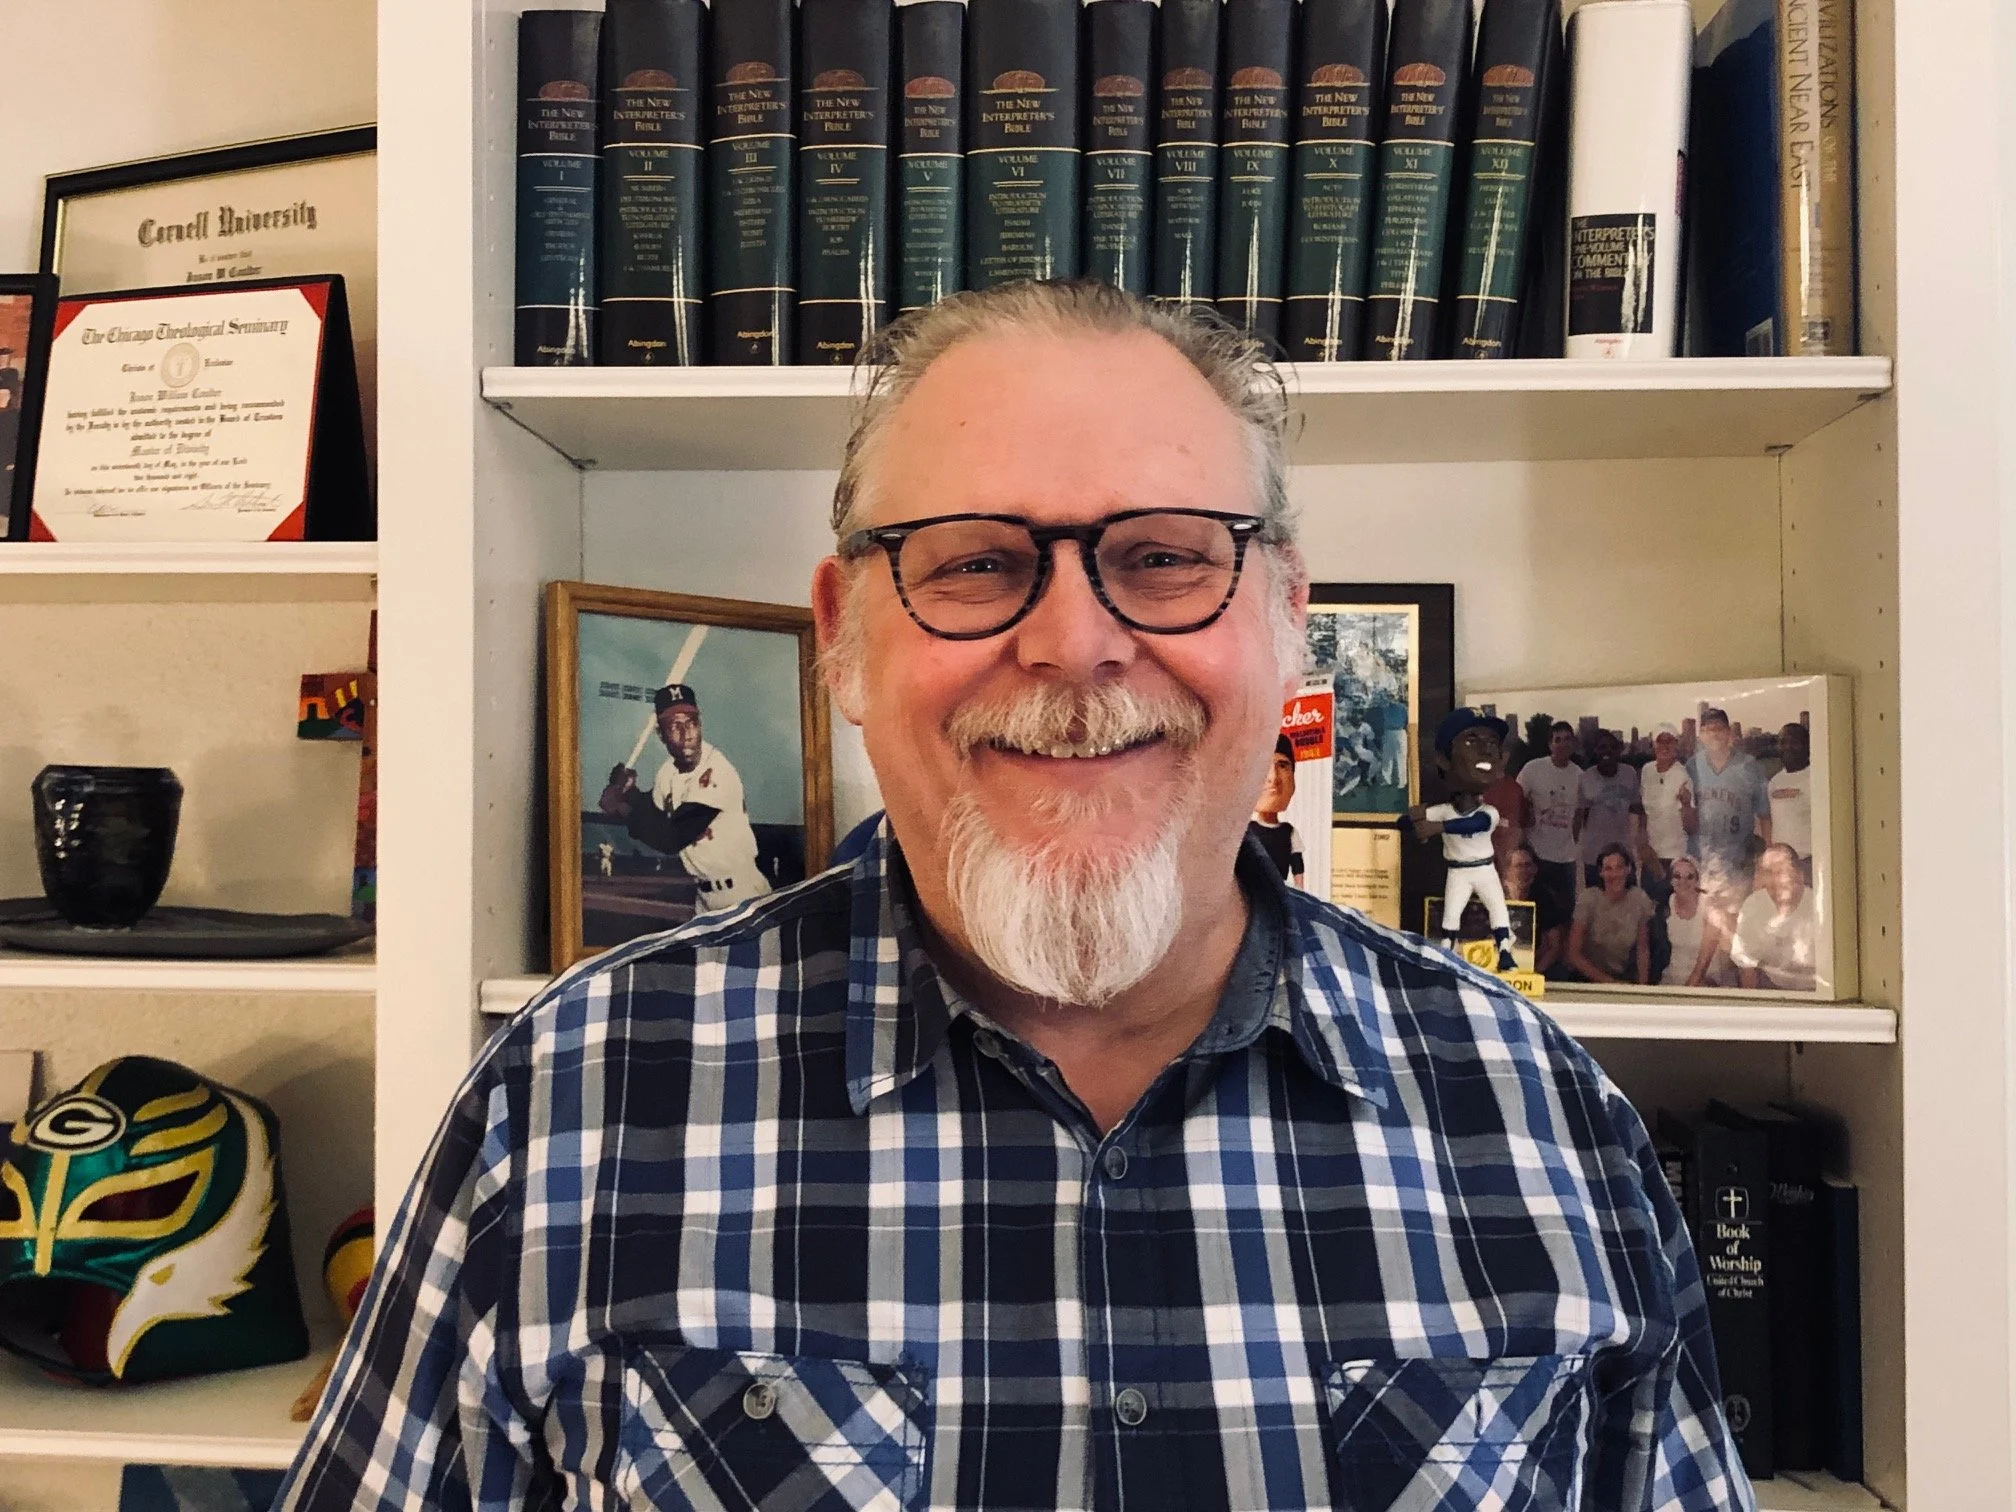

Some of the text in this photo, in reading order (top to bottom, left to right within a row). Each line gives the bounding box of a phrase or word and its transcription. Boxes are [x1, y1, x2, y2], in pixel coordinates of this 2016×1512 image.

[1818, 0, 1839, 129] VILIZATIONS
[1788, 0, 1815, 192] NCIENT NEAR EAST
[737, 113, 764, 124] BIBLE
[1176, 119, 1196, 130] BIBLE
[1241, 118, 1268, 130] BIBLE
[1322, 117, 1348, 128] BIBLE
[1405, 115, 1426, 126] BIBLE
[634, 121, 662, 131] BIBLE
[824, 121, 852, 132] BIBLE
[1004, 123, 1032, 134] BIBLE
[745, 152, 757, 163] III
[1328, 158, 1338, 169] X
[644, 160, 653, 172] II
[830, 163, 844, 174] IV
[1175, 160, 1197, 172] VIII
[1246, 160, 1260, 172] IX
[1404, 158, 1418, 170] XI
[1011, 166, 1025, 177] VI
[137, 200, 318, 248] Cornell University
[669, 686, 684, 701] M
[1281, 701, 1325, 728] cker
[31, 1097, 121, 1149] G
[1717, 1223, 1750, 1239] Book
[1726, 1240, 1740, 1256] of
[1709, 1255, 1762, 1274] Worship
